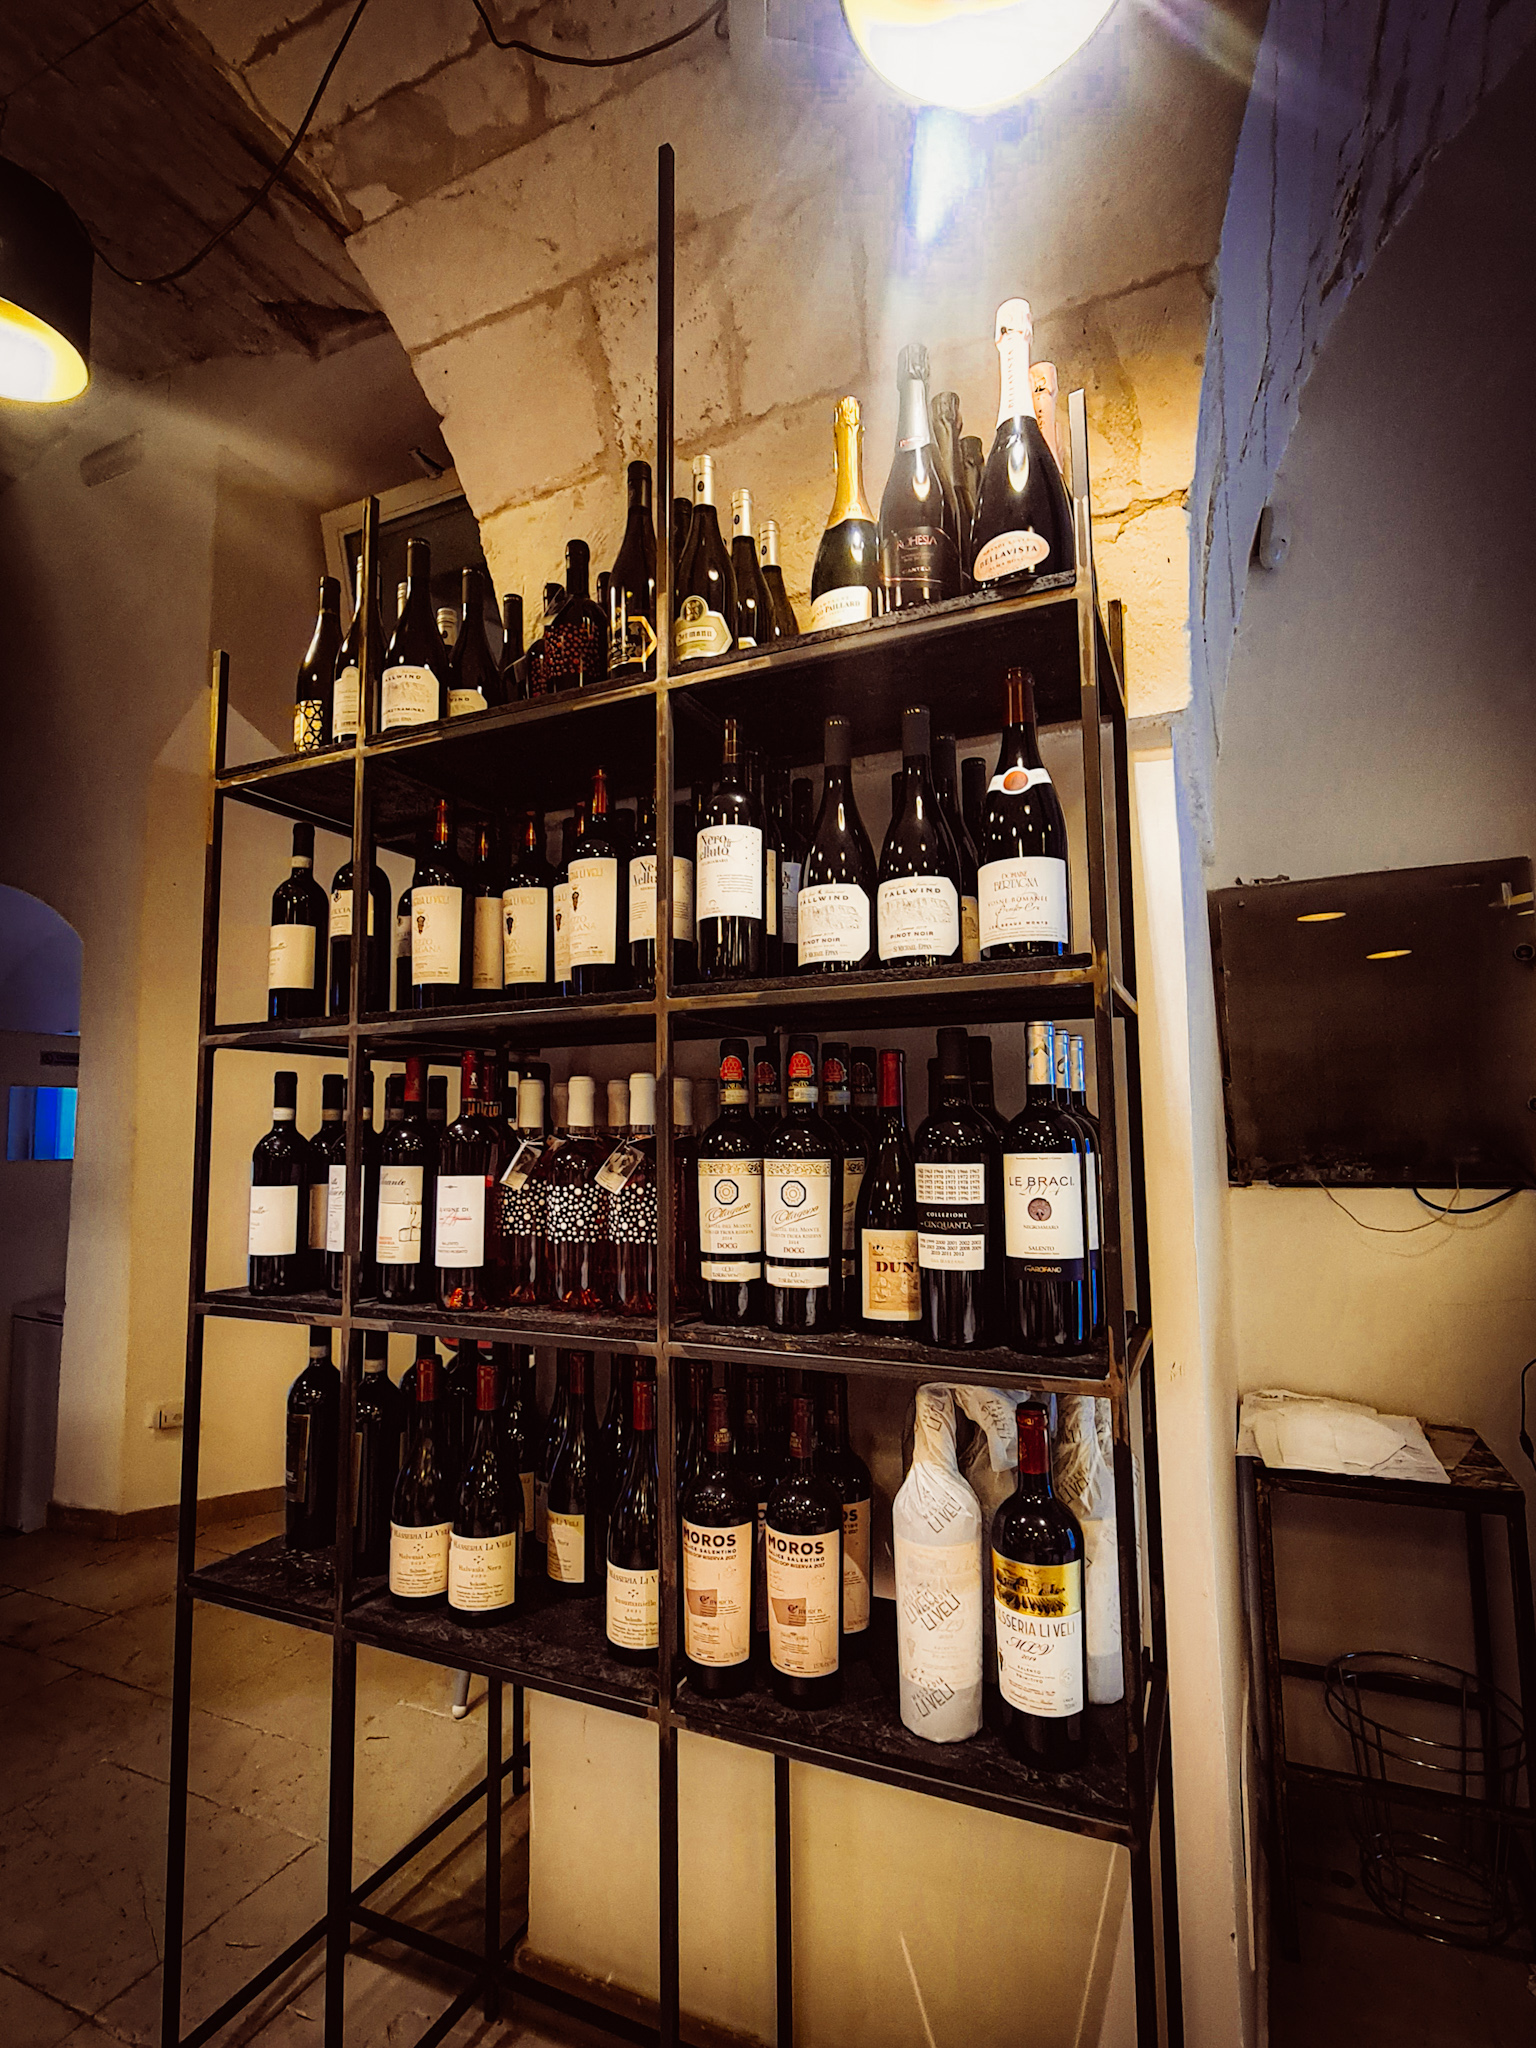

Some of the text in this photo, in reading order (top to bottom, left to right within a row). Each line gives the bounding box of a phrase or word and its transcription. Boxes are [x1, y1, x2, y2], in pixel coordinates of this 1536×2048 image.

[979, 545, 1038, 569] BELLAVISTA
[993, 877, 1039, 892] BERTAGNA
[884, 887, 941, 899] FALLWIND
[890, 931, 912, 939] PINOT
[803, 938, 820, 946] PINOT
[1009, 1176, 1022, 1186] LE
[923, 1220, 973, 1231] CINQUANTA
[783, 1246, 806, 1254] DOCG
[1024, 1264, 1062, 1274] GAROFANO
[684, 1526, 736, 1547] MOROS
[453, 1540, 483, 1551] MASSERIA
[485, 1543, 494, 1551] LI
[768, 1534, 825, 1555] MOROS
[640, 1576, 649, 1585] LI
[1040, 1623, 1050, 1638] LI
[1052, 1621, 1075, 1638] VELI
[1021, 1654, 1037, 1662] 2019
[1017, 1665, 1042, 1675] SALENTO
